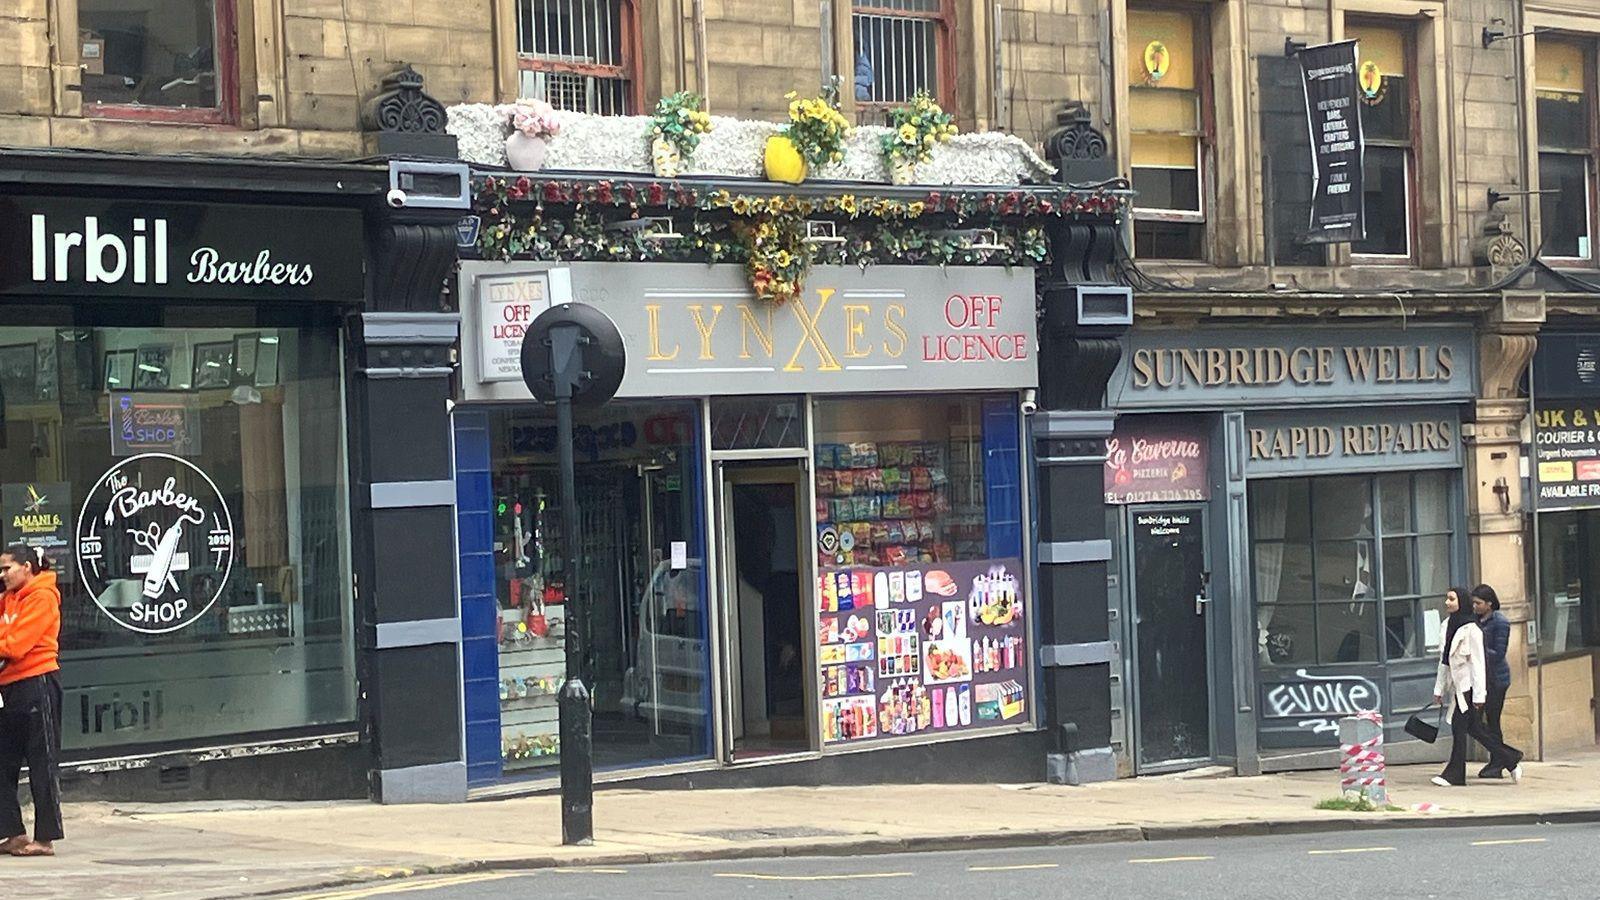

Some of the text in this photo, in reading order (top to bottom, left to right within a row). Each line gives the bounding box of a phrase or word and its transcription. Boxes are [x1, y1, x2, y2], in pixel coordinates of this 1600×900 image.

[31, 214, 313, 285] Irbil Barbers
[503, 304, 530, 323] OFF
[944, 294, 1003, 329] OFF
[493, 324, 529, 339] LICEN
[645, 288, 909, 372] LYNXES
[922, 333, 1028, 362] LICENCE
[1133, 345, 1454, 388] SUNBRIDGE WELLS
[1536, 410, 1566, 428] UK
[1573, 409, 1588, 426] &
[136, 428, 176, 442] SHOP
[1250, 420, 1452, 459] RAPID REPAIRS
[1536, 431, 1585, 444] COURIER
[1588, 430, 1595, 442] &
[1105, 438, 1127, 471] La
[105, 470, 128, 494] The
[1133, 467, 1168, 479] PIZZERIA
[115, 476, 203, 518] Barber
[1540, 484, 1600, 498] AVAILABLE FR
[81, 541, 103, 553] ESTD
[208, 535, 231, 546] 2019
[129, 599, 188, 623] SHOP
